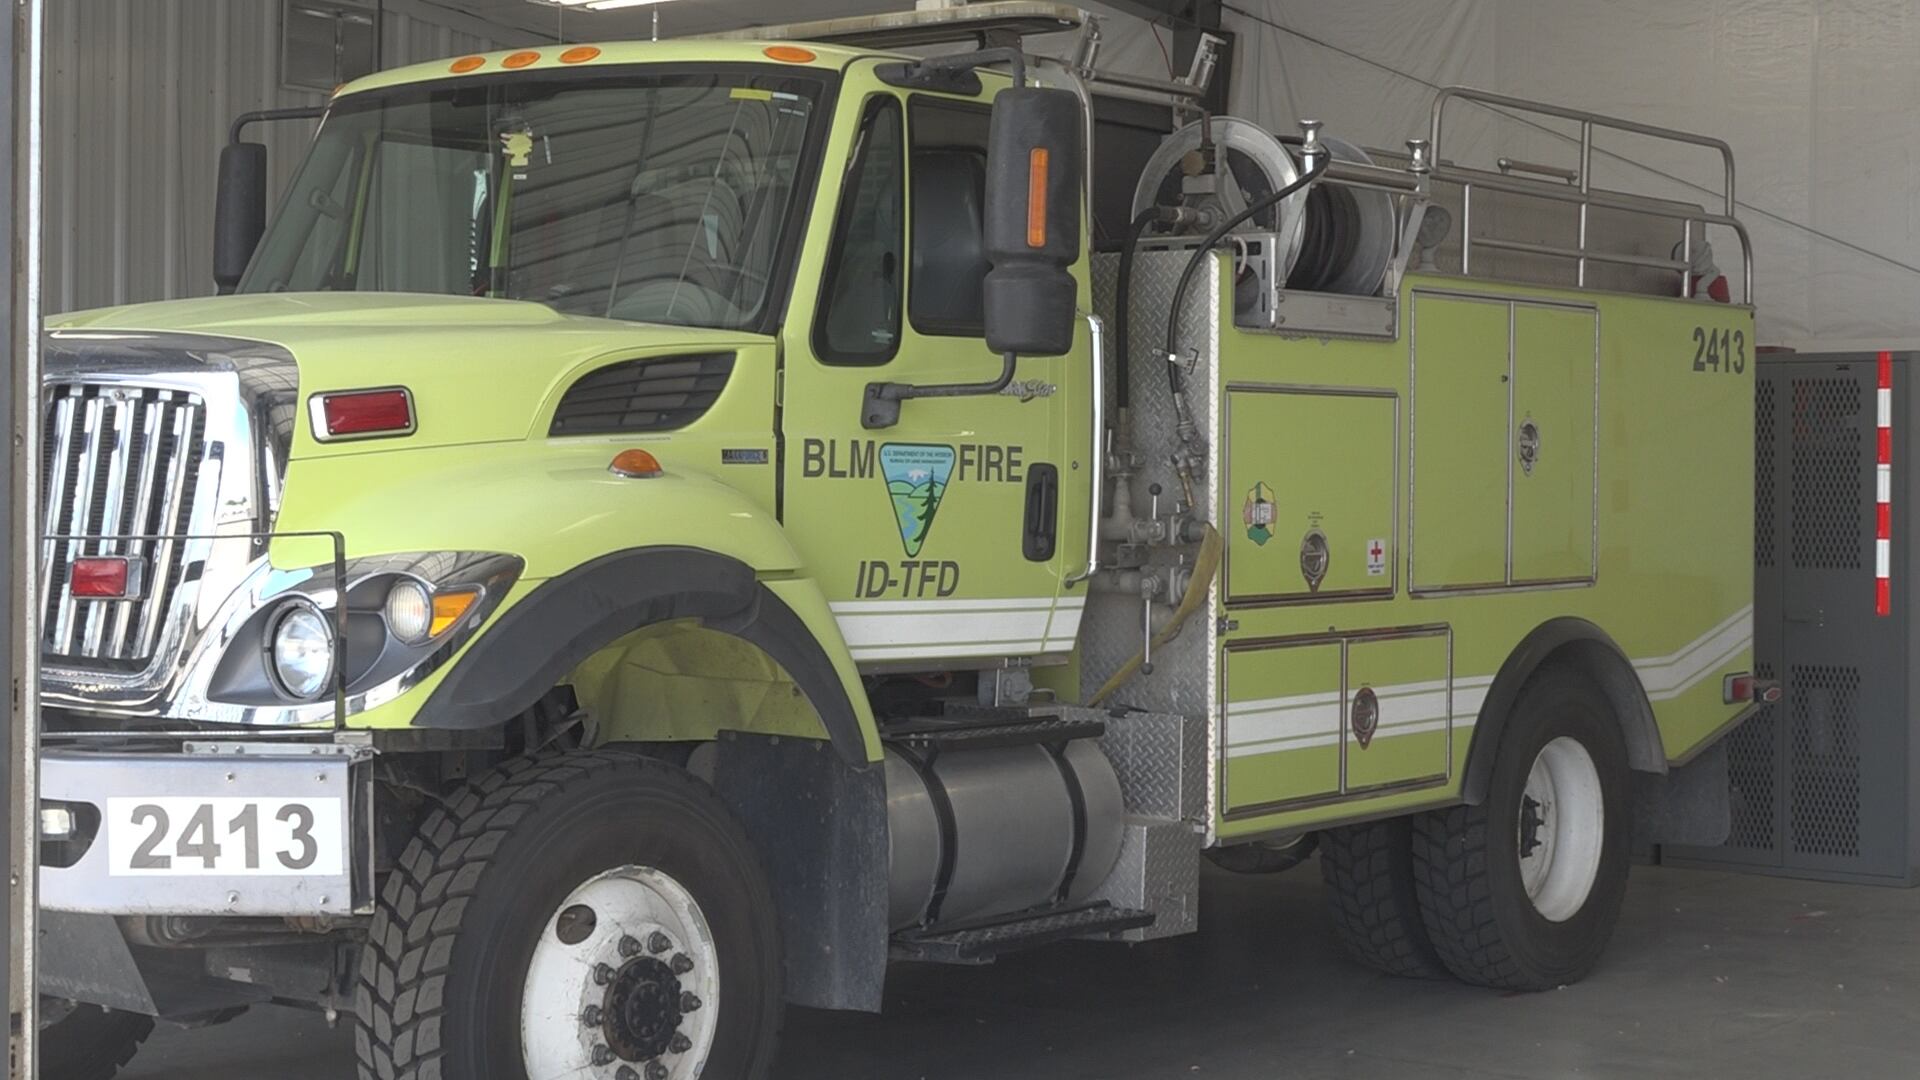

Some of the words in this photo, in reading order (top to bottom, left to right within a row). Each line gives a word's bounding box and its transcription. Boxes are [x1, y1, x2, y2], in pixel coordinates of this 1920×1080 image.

[1693, 326, 1744, 374] 2413
[802, 438, 875, 479] BLM
[958, 444, 1023, 482] FIRE
[855, 560, 960, 598] ID-TFD
[129, 803, 318, 870] 2413
